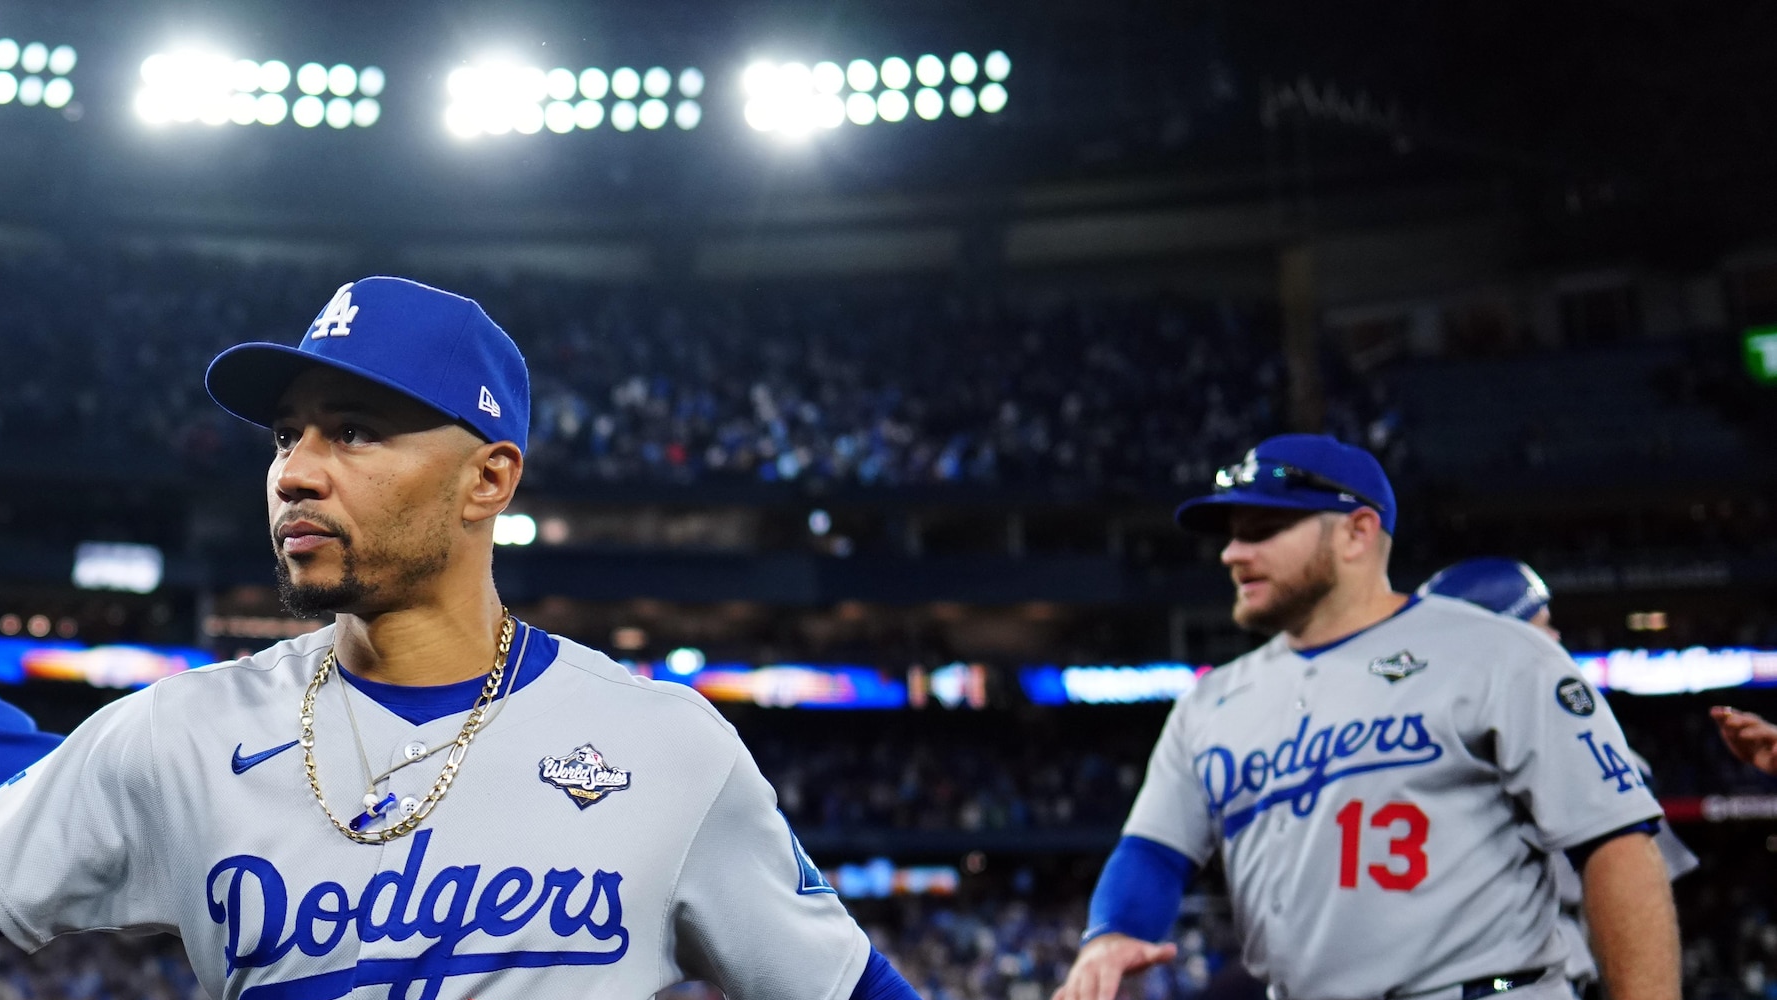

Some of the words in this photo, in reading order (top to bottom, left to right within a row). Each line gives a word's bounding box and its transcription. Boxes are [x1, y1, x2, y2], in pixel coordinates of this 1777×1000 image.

[311, 282, 360, 340] LA
[542, 757, 591, 783] World
[582, 765, 629, 790] Series
[1193, 712, 1444, 839] Dodgers
[1577, 730, 1646, 794] LA
[1334, 798, 1431, 893] 13
